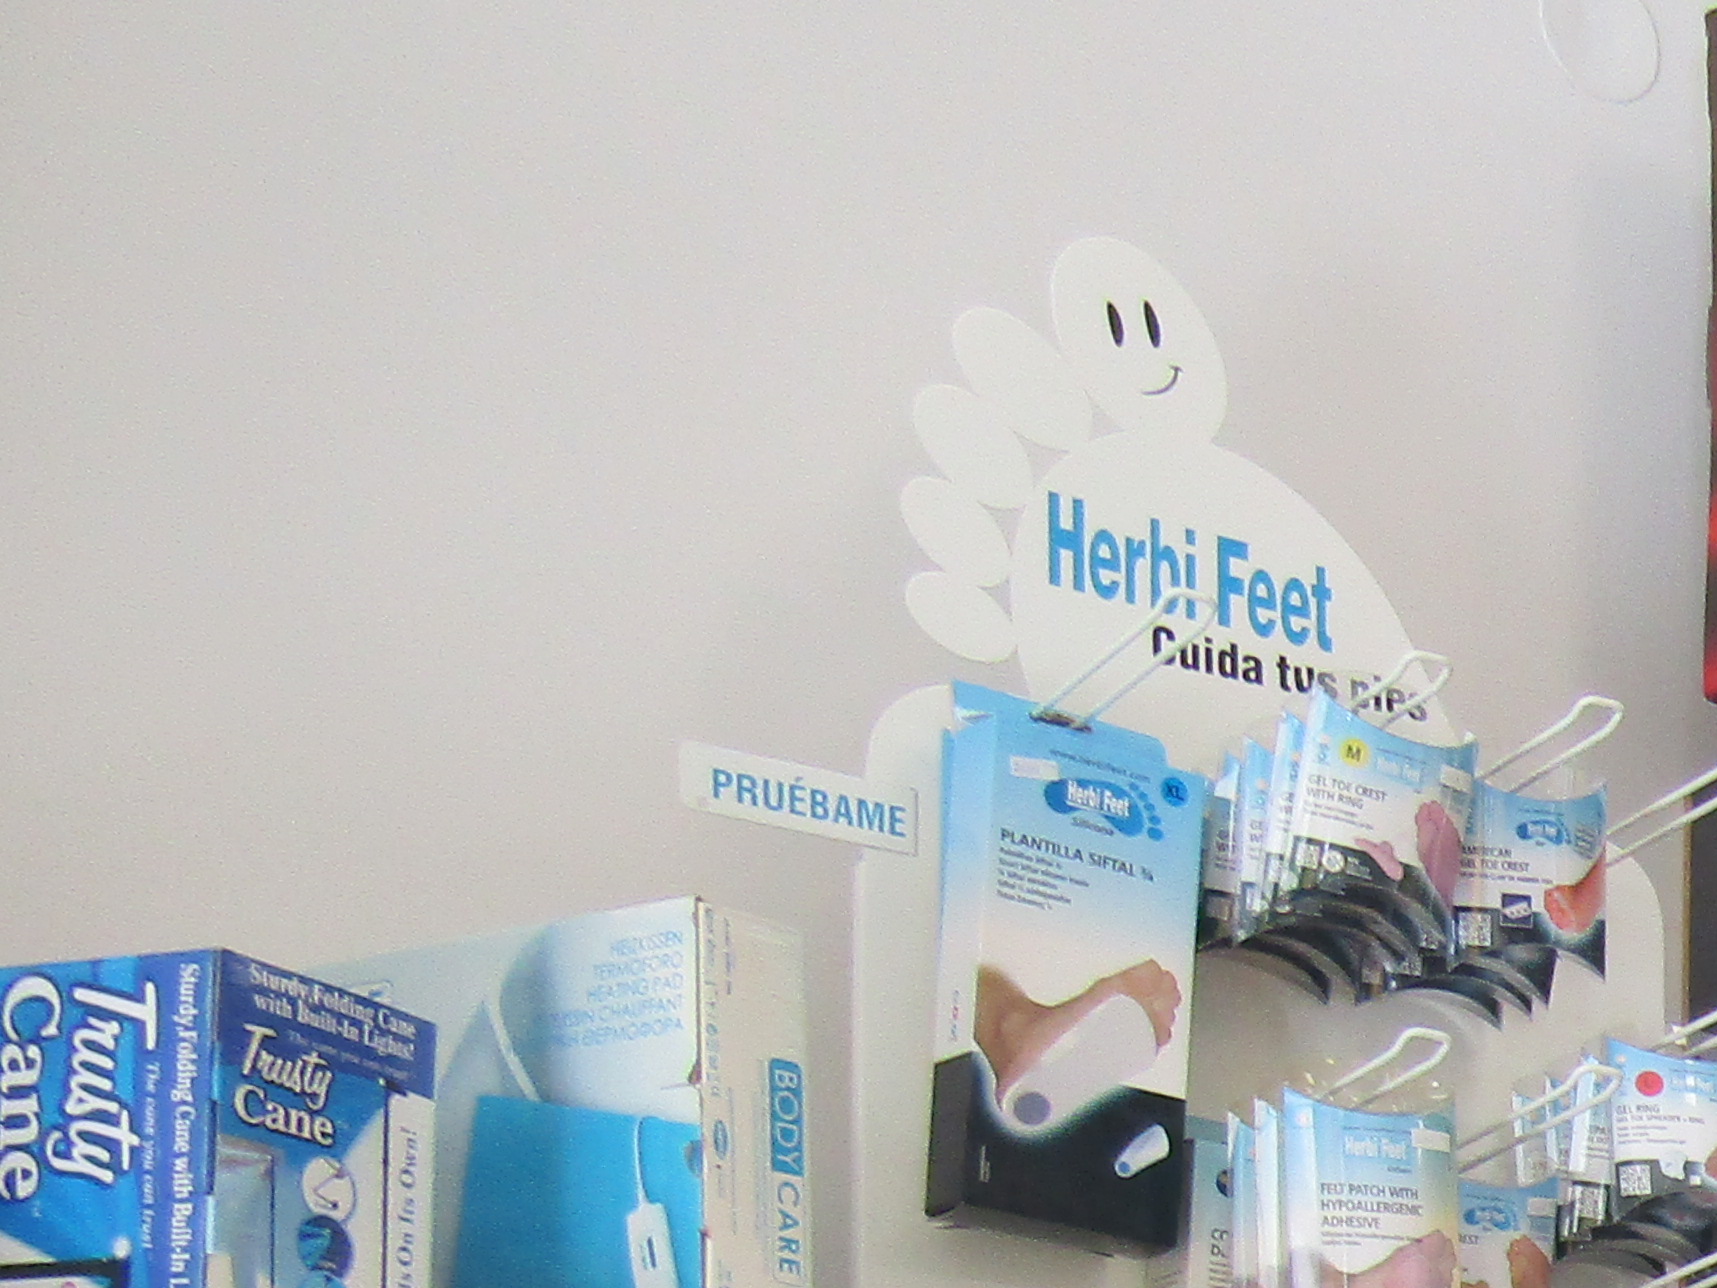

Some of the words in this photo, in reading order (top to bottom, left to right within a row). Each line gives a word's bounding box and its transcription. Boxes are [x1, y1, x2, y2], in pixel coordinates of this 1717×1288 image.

[1048, 489, 1199, 622] Herbi
[1217, 535, 1335, 654] Feet
[1345, 745, 1362, 763] M
[712, 775, 907, 840] PRUÉBAME
[1066, 779, 1101, 811] Herbi
[1103, 788, 1131, 818] Feet
[1001, 826, 1084, 864] PLANTILLA
[1089, 843, 1135, 878] SIFTAL
[254, 992, 294, 1021] with
[378, 1005, 418, 1038] Cane
[46, 981, 160, 1186] Trusty
[242, 1022, 336, 1113] Trusty
[172, 1105, 197, 1153] Cane
[233, 1083, 336, 1148] Cane
[774, 1067, 801, 1174] BODY
[171, 1157, 195, 1199] with
[398, 1125, 418, 1190] Own!
[1348, 1183, 1386, 1199] PATCH
[1389, 1186, 1419, 1201] WITH
[776, 1182, 801, 1277] CARE
[1320, 1215, 1381, 1231] ADHESIVE
[393, 1232, 416, 1268] On
